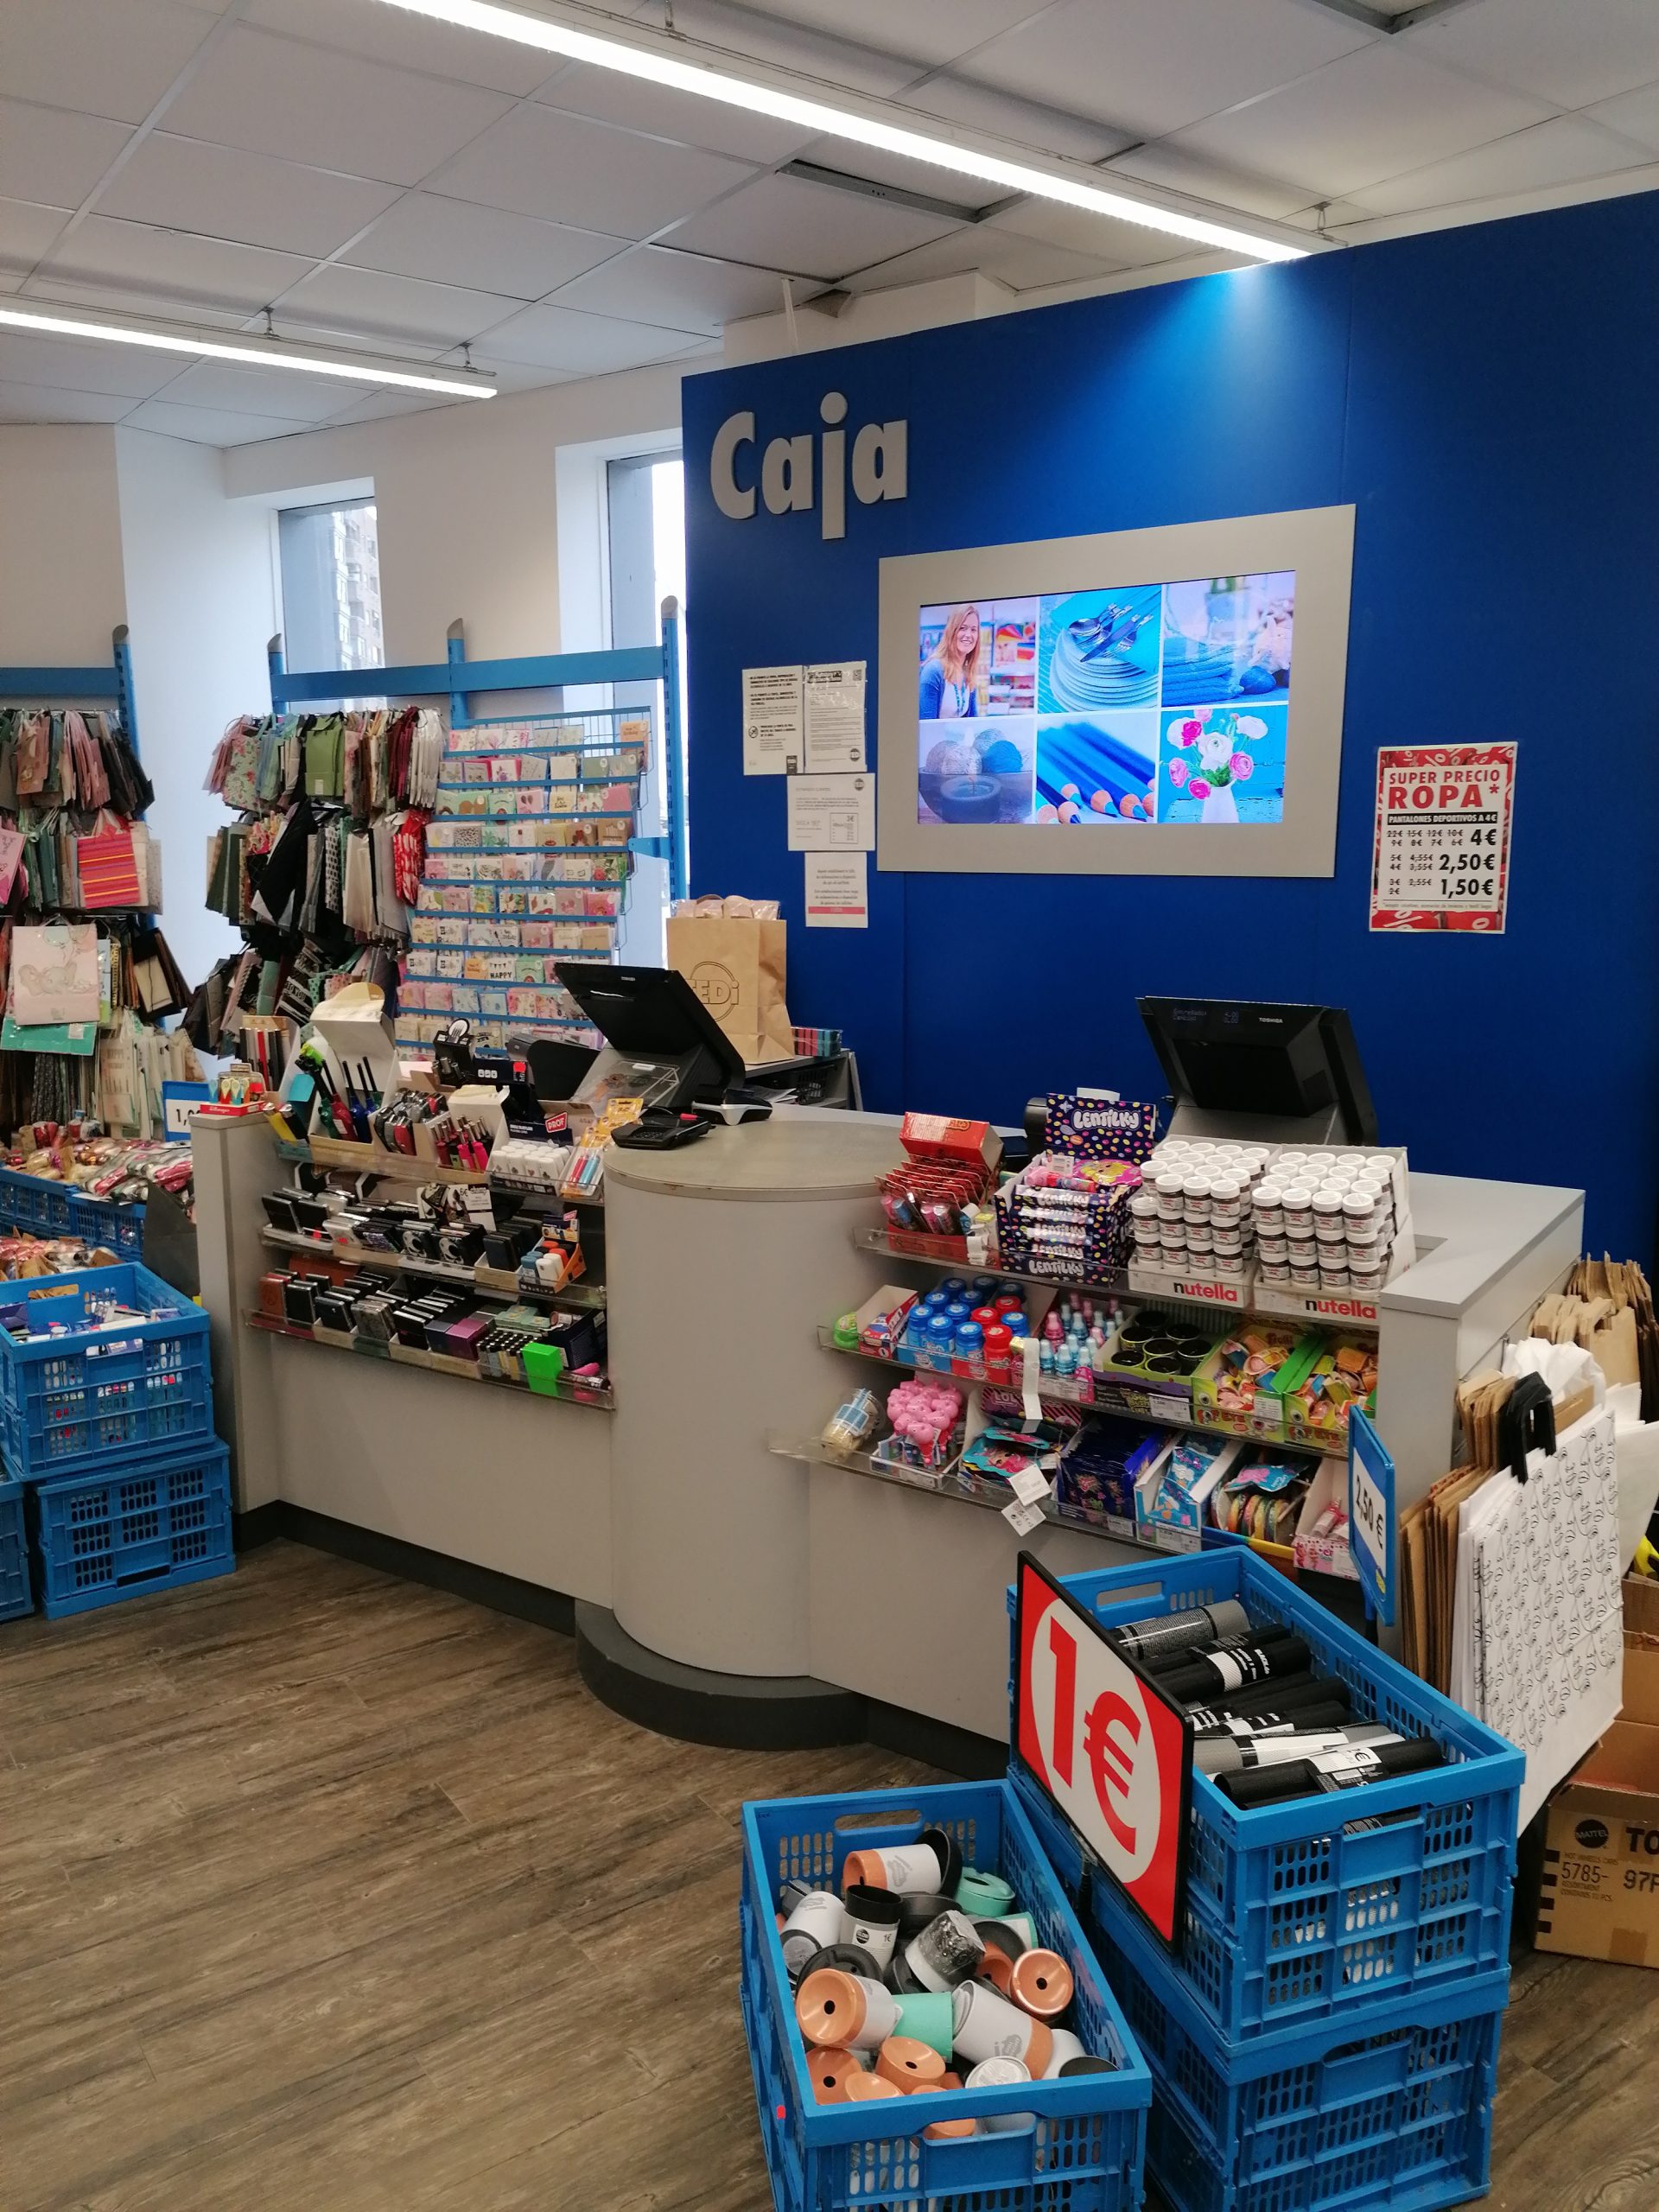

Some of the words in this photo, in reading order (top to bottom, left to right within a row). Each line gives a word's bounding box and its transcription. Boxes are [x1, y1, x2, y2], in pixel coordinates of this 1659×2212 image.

[710, 391, 907, 540] Caja
[1389, 772, 1437, 785] SUPER
[1444, 769, 1500, 783] PRECIO
[1389, 815, 1432, 823] PANTALONES
[1440, 853, 1495, 874] 2,50€
[1440, 879, 1493, 899] 1,50€
[548, 1116, 565, 1129] PROF
[1173, 1281, 1237, 1302] nutella
[1306, 1300, 1376, 1319] nutella
